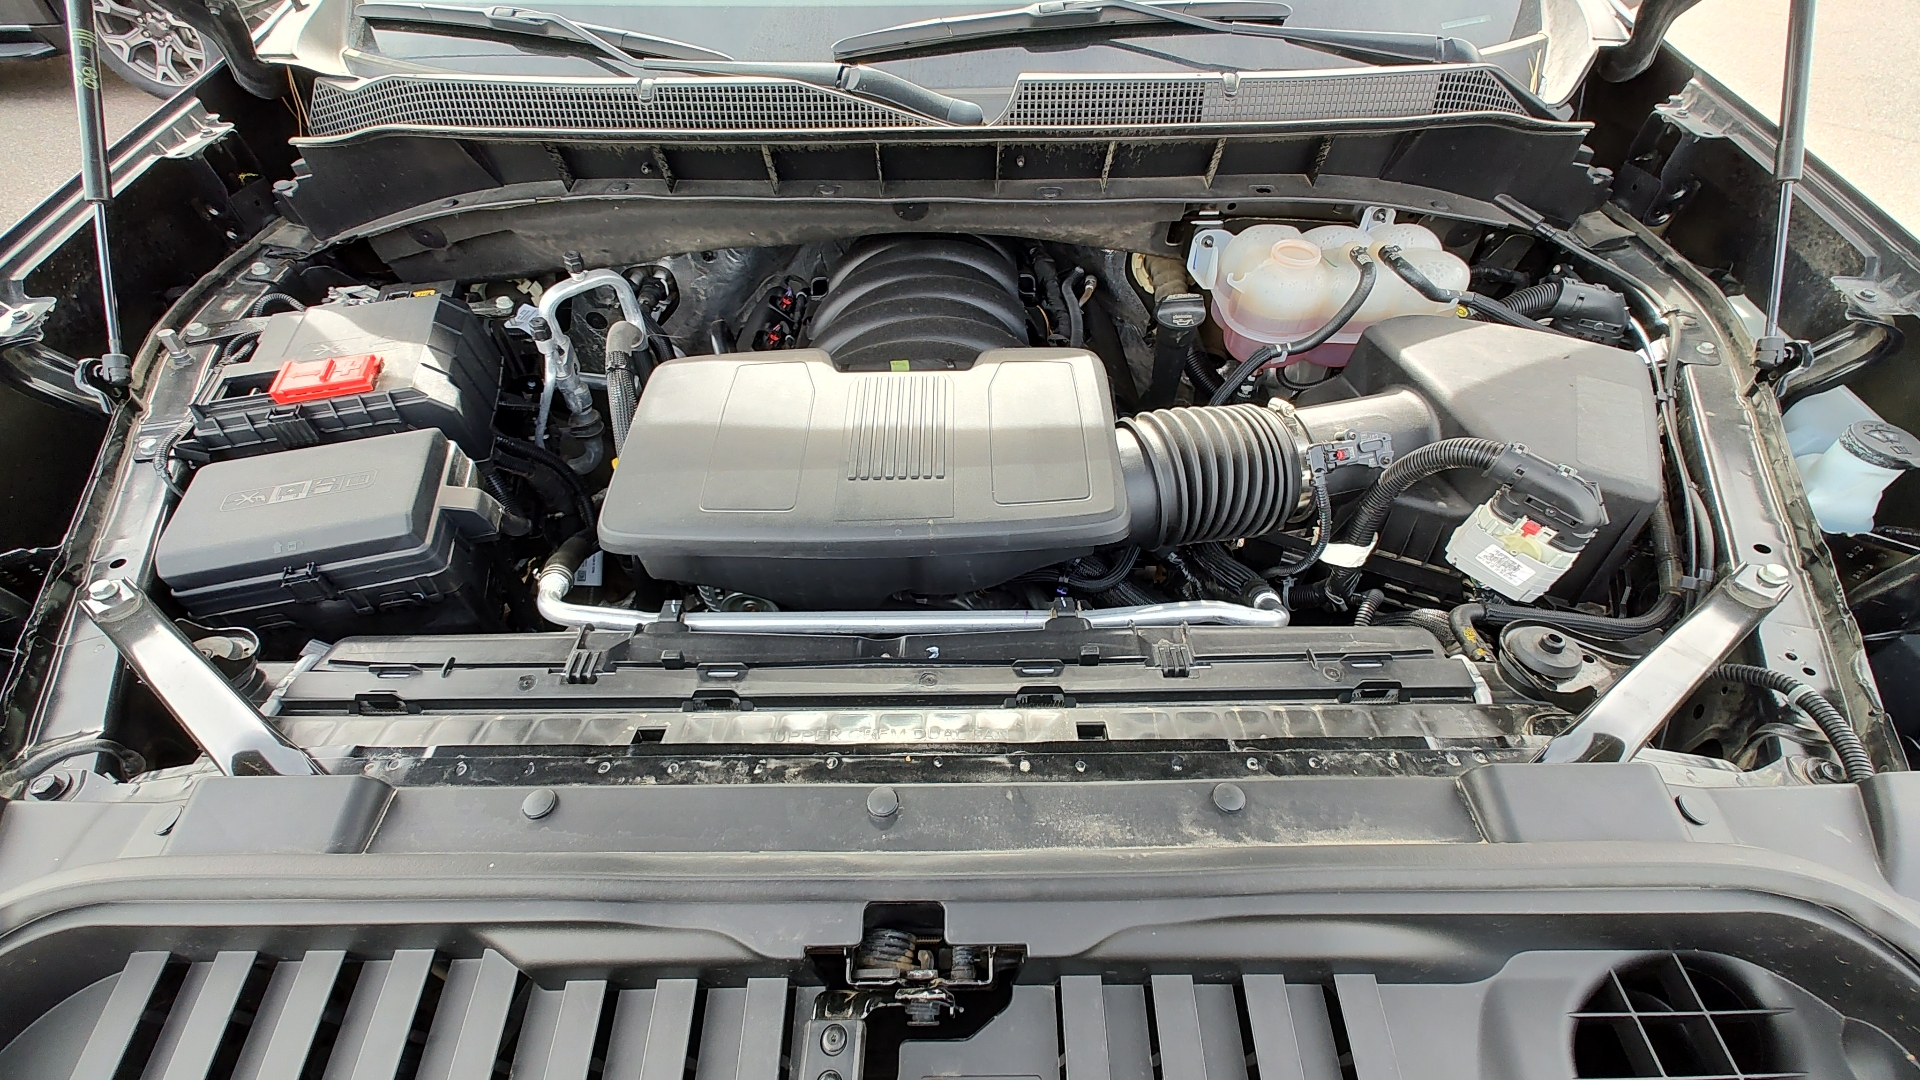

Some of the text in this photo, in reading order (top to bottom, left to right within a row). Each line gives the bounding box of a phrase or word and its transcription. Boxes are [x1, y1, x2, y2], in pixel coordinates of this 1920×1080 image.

[773, 728, 842, 742] UPPER
[913, 727, 967, 741] DUAL
[971, 728, 1010, 741] FAN
